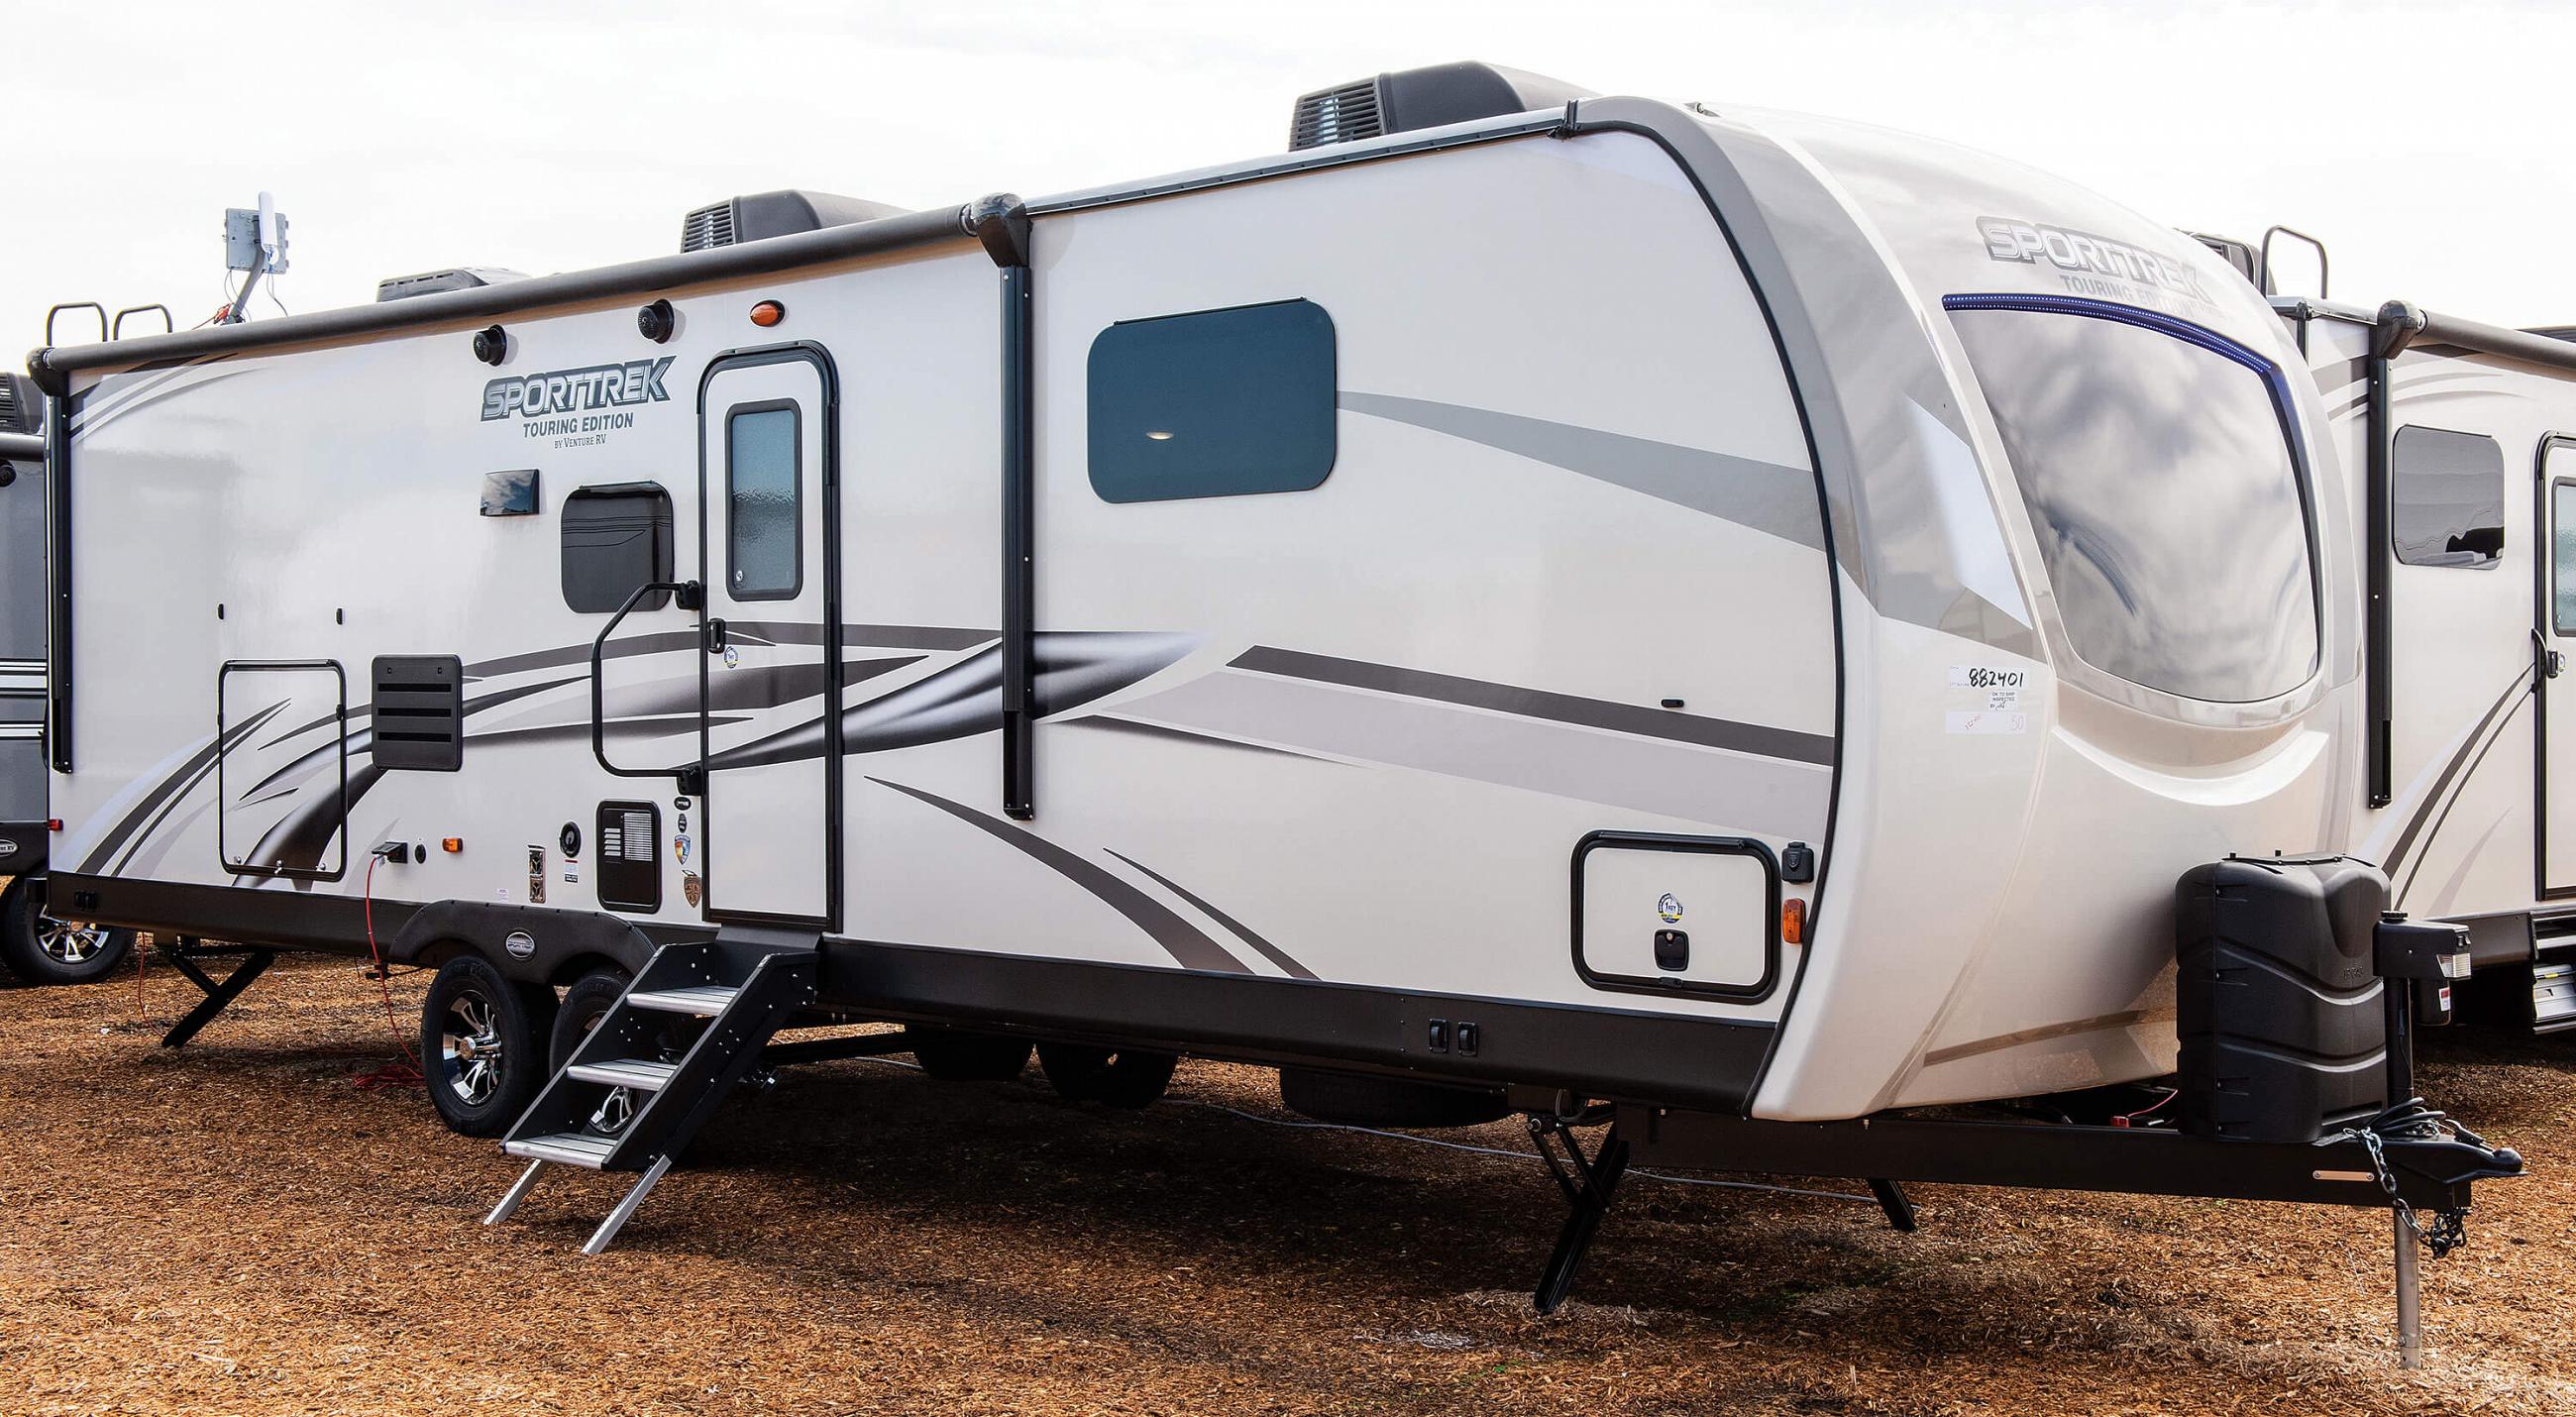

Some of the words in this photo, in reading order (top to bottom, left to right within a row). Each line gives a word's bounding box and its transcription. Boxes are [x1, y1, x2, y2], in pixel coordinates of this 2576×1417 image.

[1975, 215, 2216, 306] SPORTTREK
[2060, 274, 2134, 300] TOURING
[481, 355, 677, 421] SPORTTREK
[523, 417, 578, 438] TOURING
[582, 412, 634, 432] EDITION
[595, 434, 606, 445] RV
[1969, 668, 2023, 688] 882401
